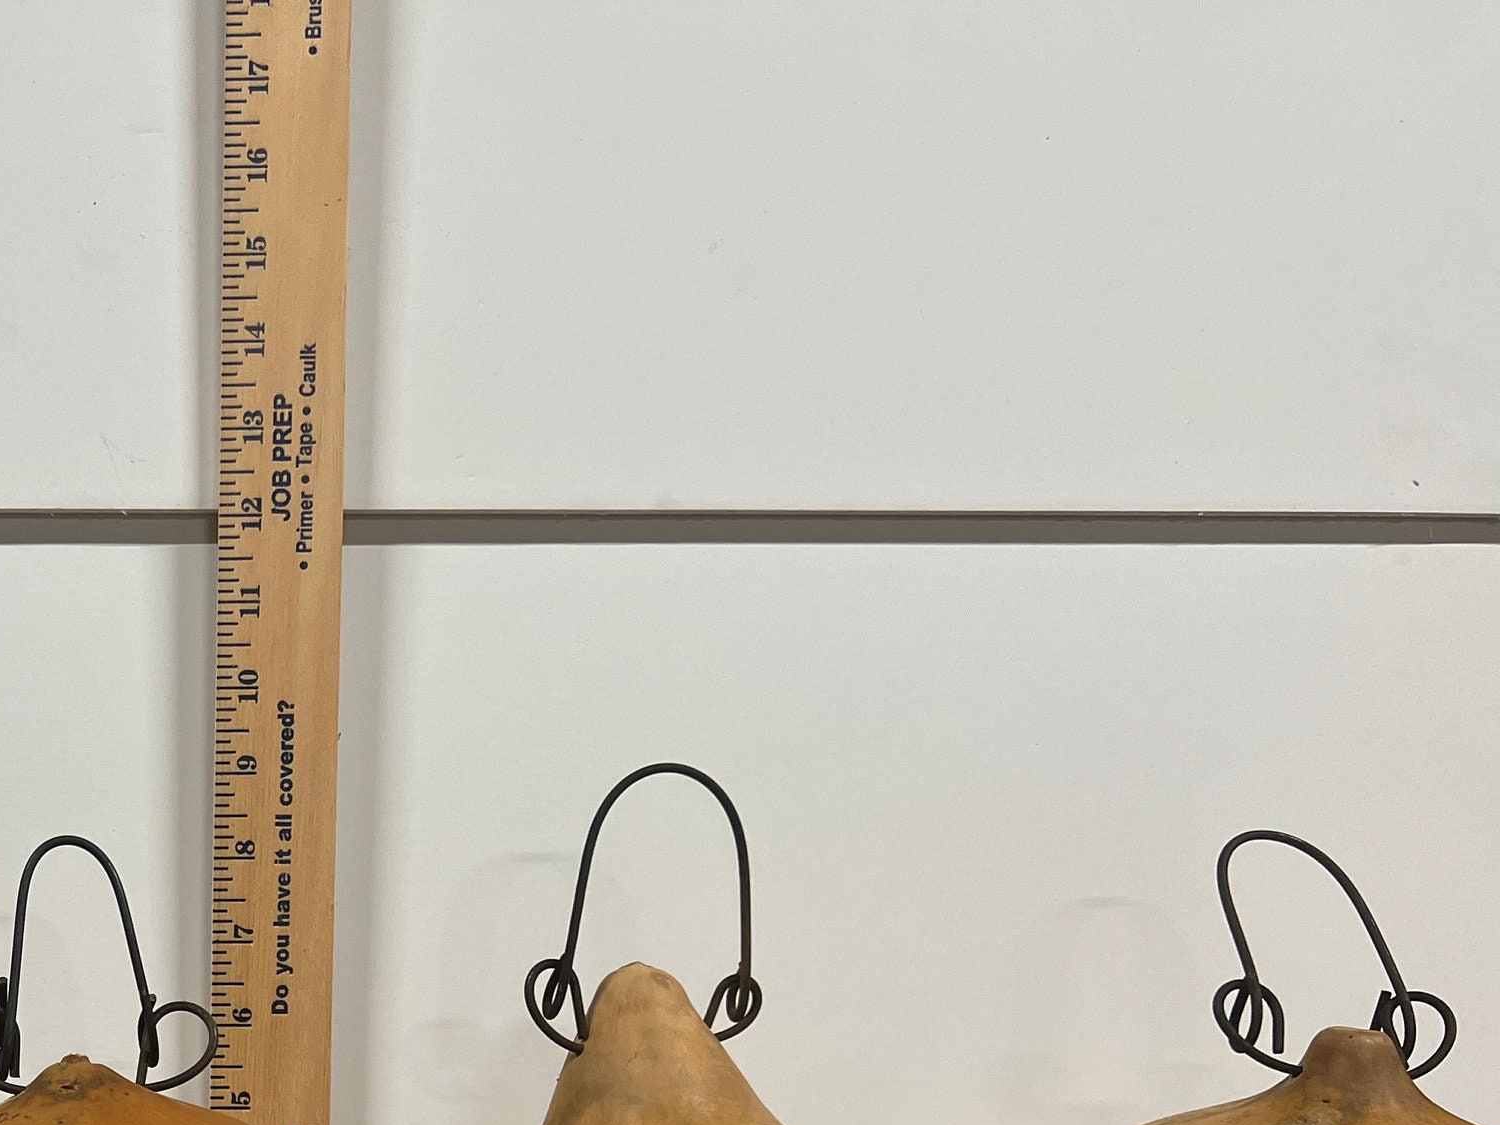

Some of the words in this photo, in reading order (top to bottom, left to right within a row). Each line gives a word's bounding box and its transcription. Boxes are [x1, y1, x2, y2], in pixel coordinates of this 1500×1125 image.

[247, 60, 269, 95] 17
[246, 148, 268, 183] 16
[245, 236, 267, 270] 15
[244, 322, 265, 357] 14
[299, 343, 317, 397] Caulk
[243, 410, 264, 444] 13
[272, 394, 293, 462] PREP
[296, 422, 316, 468] Tape
[271, 470, 292, 522] JOB
[241, 497, 262, 531] 12
[296, 491, 314, 553] Primer
[239, 585, 261, 618] 11
[238, 669, 259, 704] 10
[236, 755, 257, 771] 9
[276, 700, 295, 806] covered?
[275, 814, 292, 842] all
[235, 840, 255, 855] 8
[274, 849, 292, 864] it
[273, 872, 291, 927] have
[233, 924, 254, 939] 7
[276, 934, 294, 976] you
[232, 1008, 252, 1023] 6
[271, 984, 289, 1015] Do
[231, 1091, 251, 1105] 5
